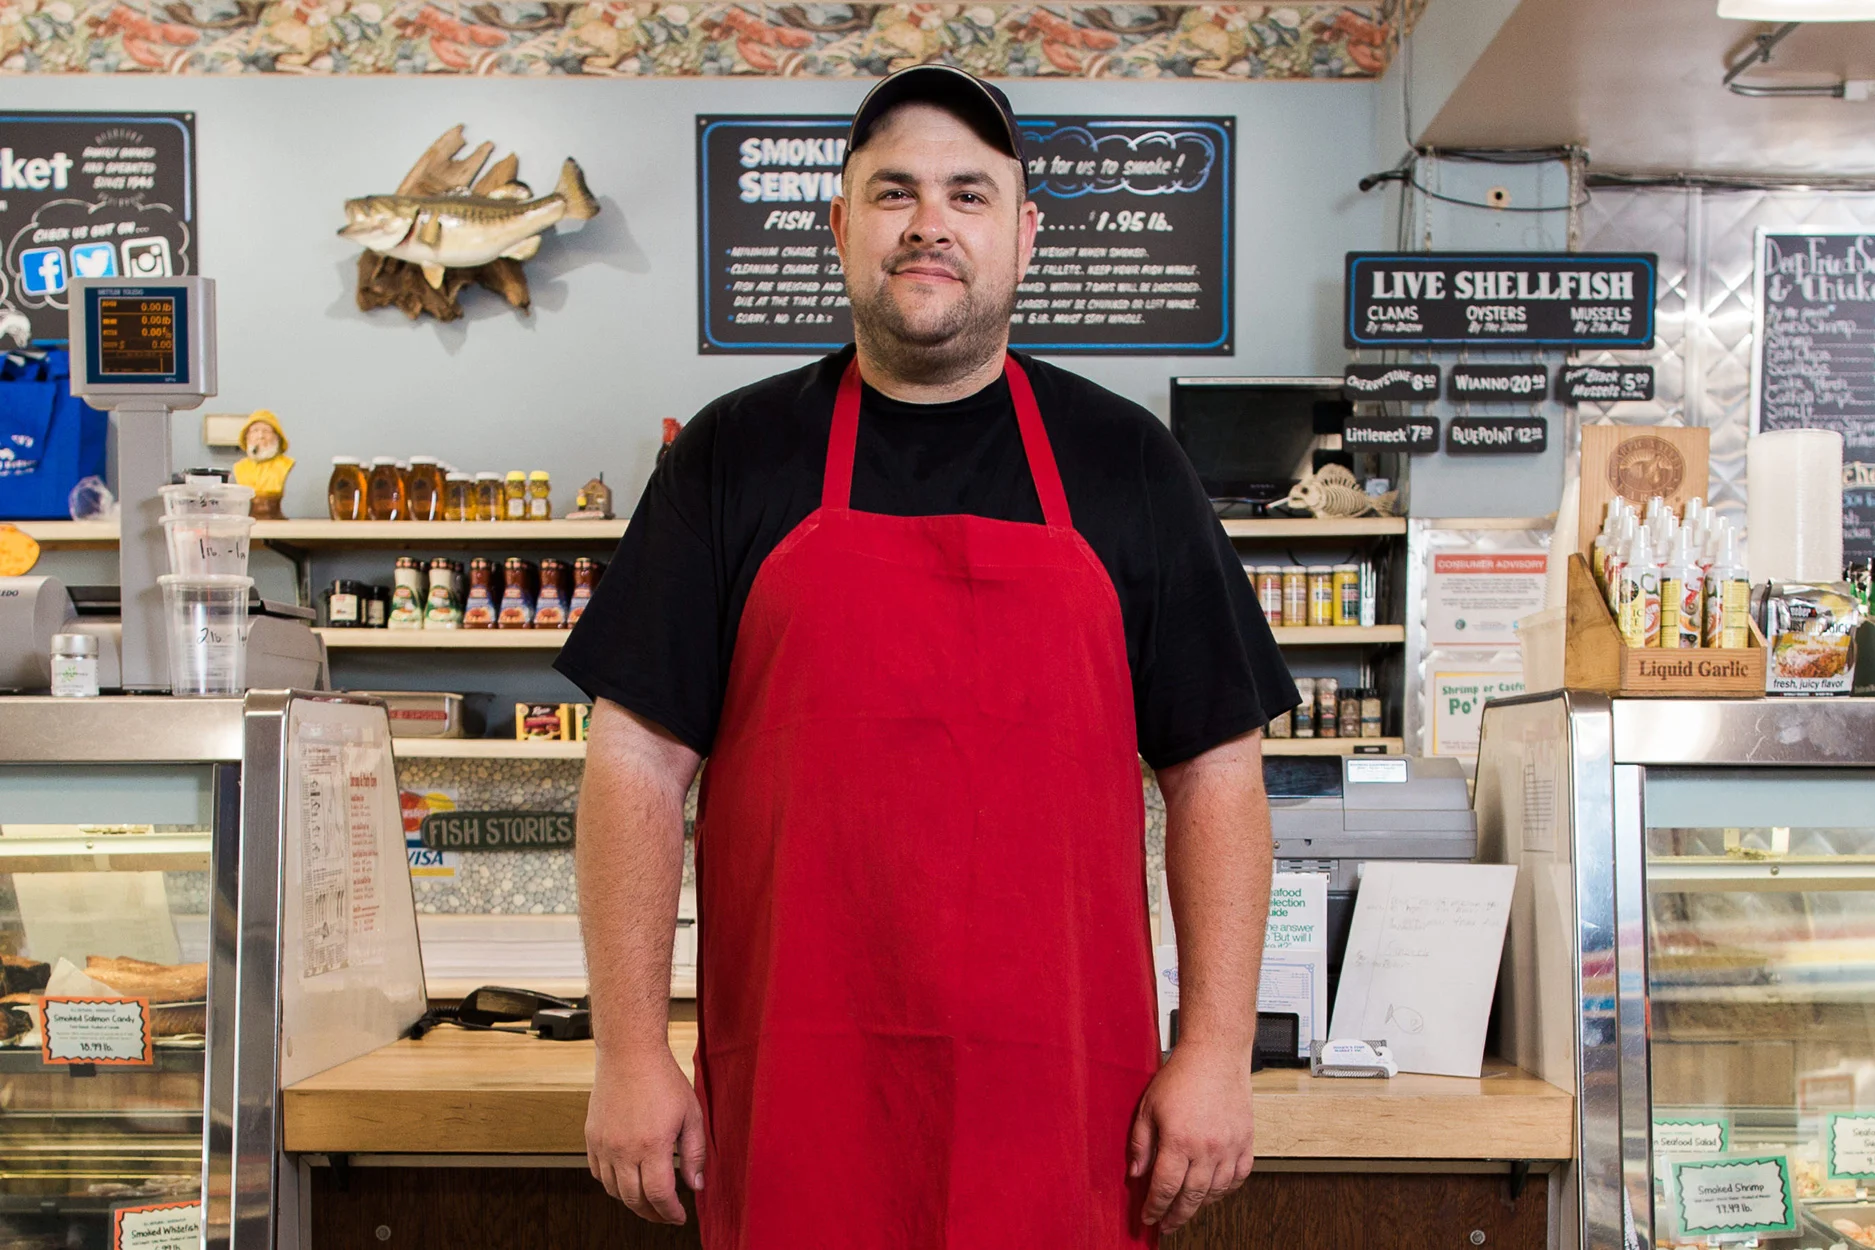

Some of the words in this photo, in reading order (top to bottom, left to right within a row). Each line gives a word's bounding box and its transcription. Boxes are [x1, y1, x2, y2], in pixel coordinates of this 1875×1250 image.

[1050, 155, 1074, 174] for
[1075, 161, 1096, 175] us
[1100, 159, 1119, 175] to
[33, 227, 70, 243] CHECK
[72, 226, 89, 239] US
[90, 222, 115, 238] OUT
[781, 246, 818, 257] CHARGE
[1039, 247, 1077, 258] WEIGHT
[1078, 247, 1108, 258] WHEN
[730, 263, 780, 275] CLEANING
[782, 263, 820, 275] CHARGE
[1087, 264, 1112, 275] KEEP
[1112, 264, 1141, 275] YOUR
[777, 281, 821, 292] WEIGHED
[821, 282, 844, 292] AND
[1371, 271, 1446, 300] LIVE
[1454, 271, 1634, 300] SHELLFISH
[771, 295, 790, 307] THE
[792, 295, 818, 307] TIME
[141, 302, 161, 312] 0.00
[773, 312, 790, 324] NO
[1367, 305, 1419, 321] CLAMS
[1466, 305, 1527, 321] OYSTERS
[1570, 306, 1632, 321] MUSSELS
[141, 315, 161, 325] 0.00
[141, 328, 162, 337] 0.00
[151, 340, 173, 349] 0.00
[1455, 374, 1509, 391] WIANNO
[1346, 427, 1407, 443] Littleneck
[1437, 560, 1494, 569] CONSUMER
[1495, 560, 1545, 569] ADVISORY
[1638, 660, 1693, 681] Liquid
[1698, 660, 1749, 677] Garlic
[1773, 679, 1797, 689] fresh,
[1799, 679, 1819, 690] juicy
[1821, 679, 1845, 688] flavor
[1442, 685, 1479, 696] Shrimp
[428, 819, 480, 847] FISH
[485, 816, 573, 844] STORIES
[1292, 933, 1307, 942] will
[53, 1014, 82, 1023] Smoked
[84, 1014, 110, 1022] Salmon
[112, 1014, 135, 1024] Candy
[1660, 1137, 1693, 1147] Seafood
[1694, 1137, 1718, 1146] Salad
[1698, 1183, 1733, 1196] Smoked
[1735, 1181, 1765, 1193] Shrimp
[131, 1227, 161, 1240] Smoked
[163, 1223, 198, 1234] Whitefish
